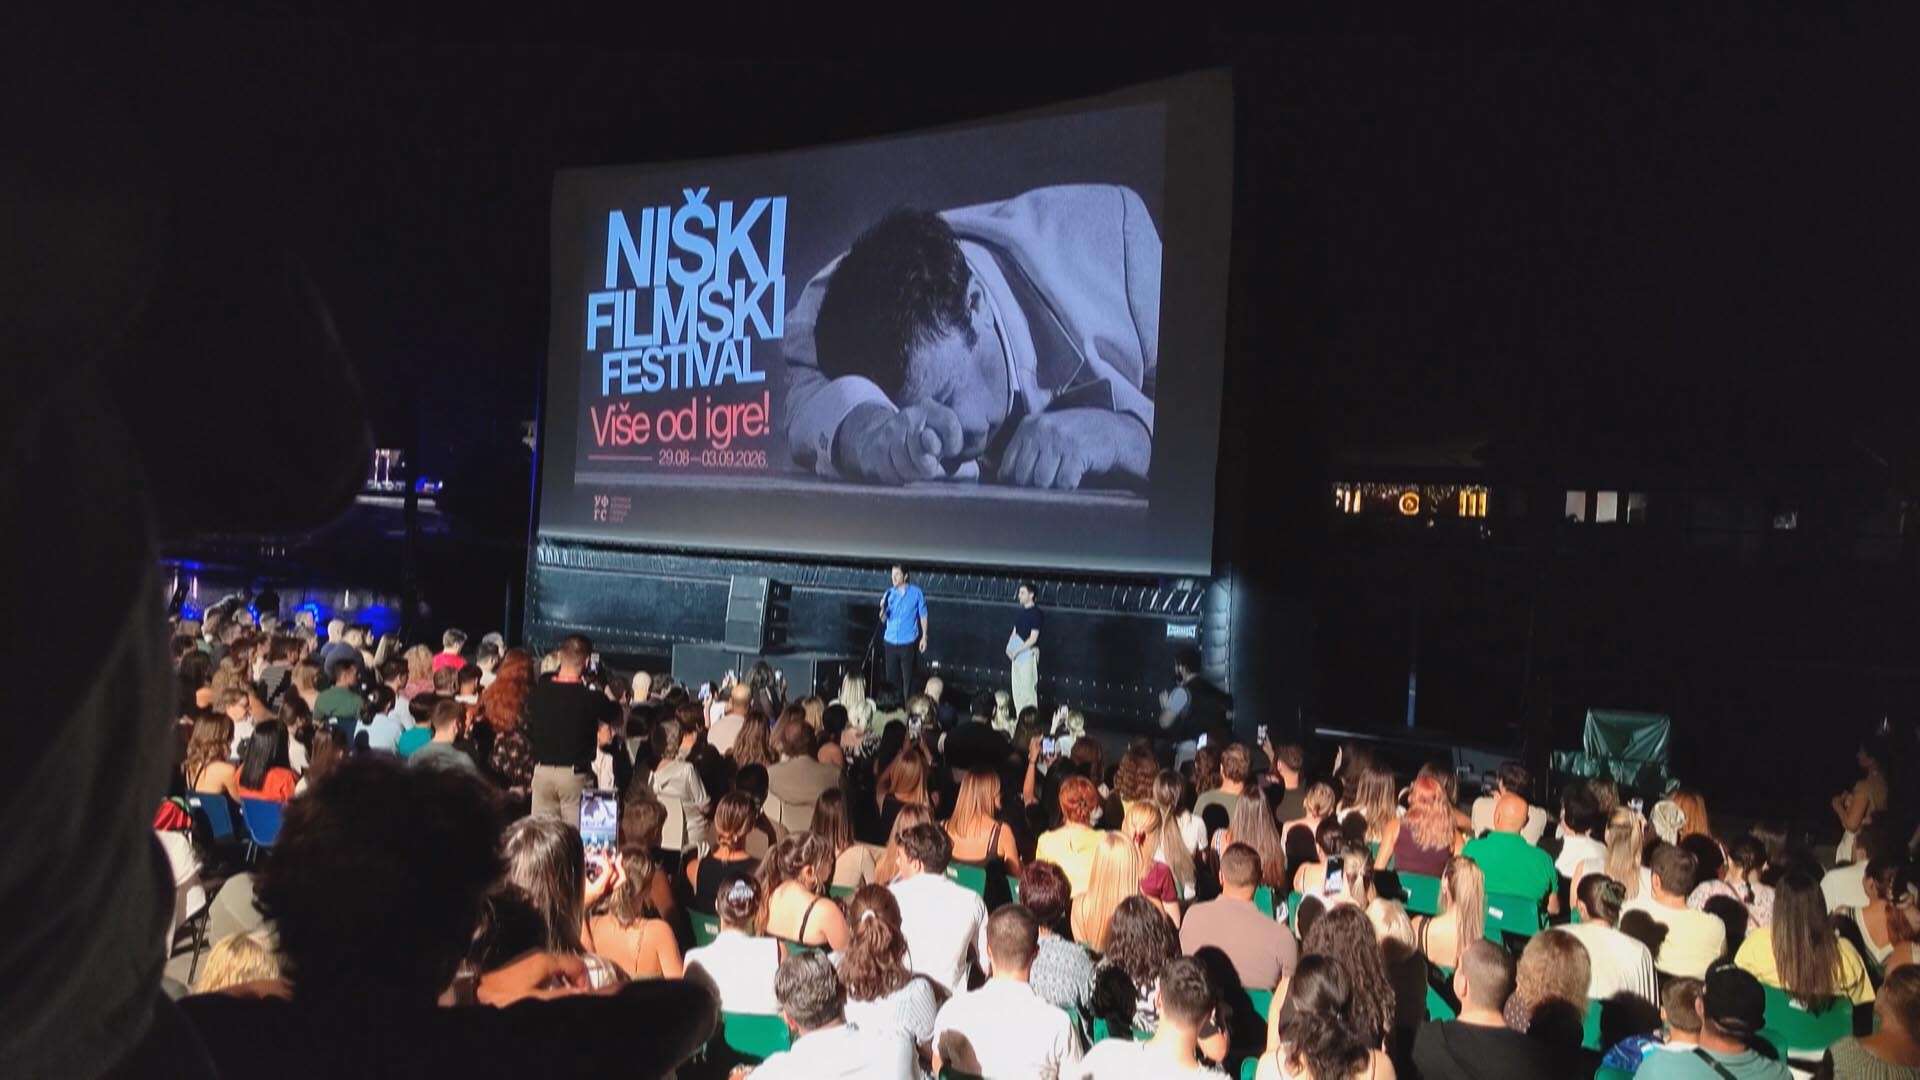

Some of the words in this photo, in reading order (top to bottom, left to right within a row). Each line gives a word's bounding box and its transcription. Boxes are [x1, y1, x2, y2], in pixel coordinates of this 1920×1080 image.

[605, 186, 787, 289] NIŠKI
[586, 275, 786, 351] FILMSKI
[602, 336, 766, 397] FESTIVAL
[590, 402, 651, 447] Više
[656, 396, 698, 443] od
[705, 390, 770, 450] igre!
